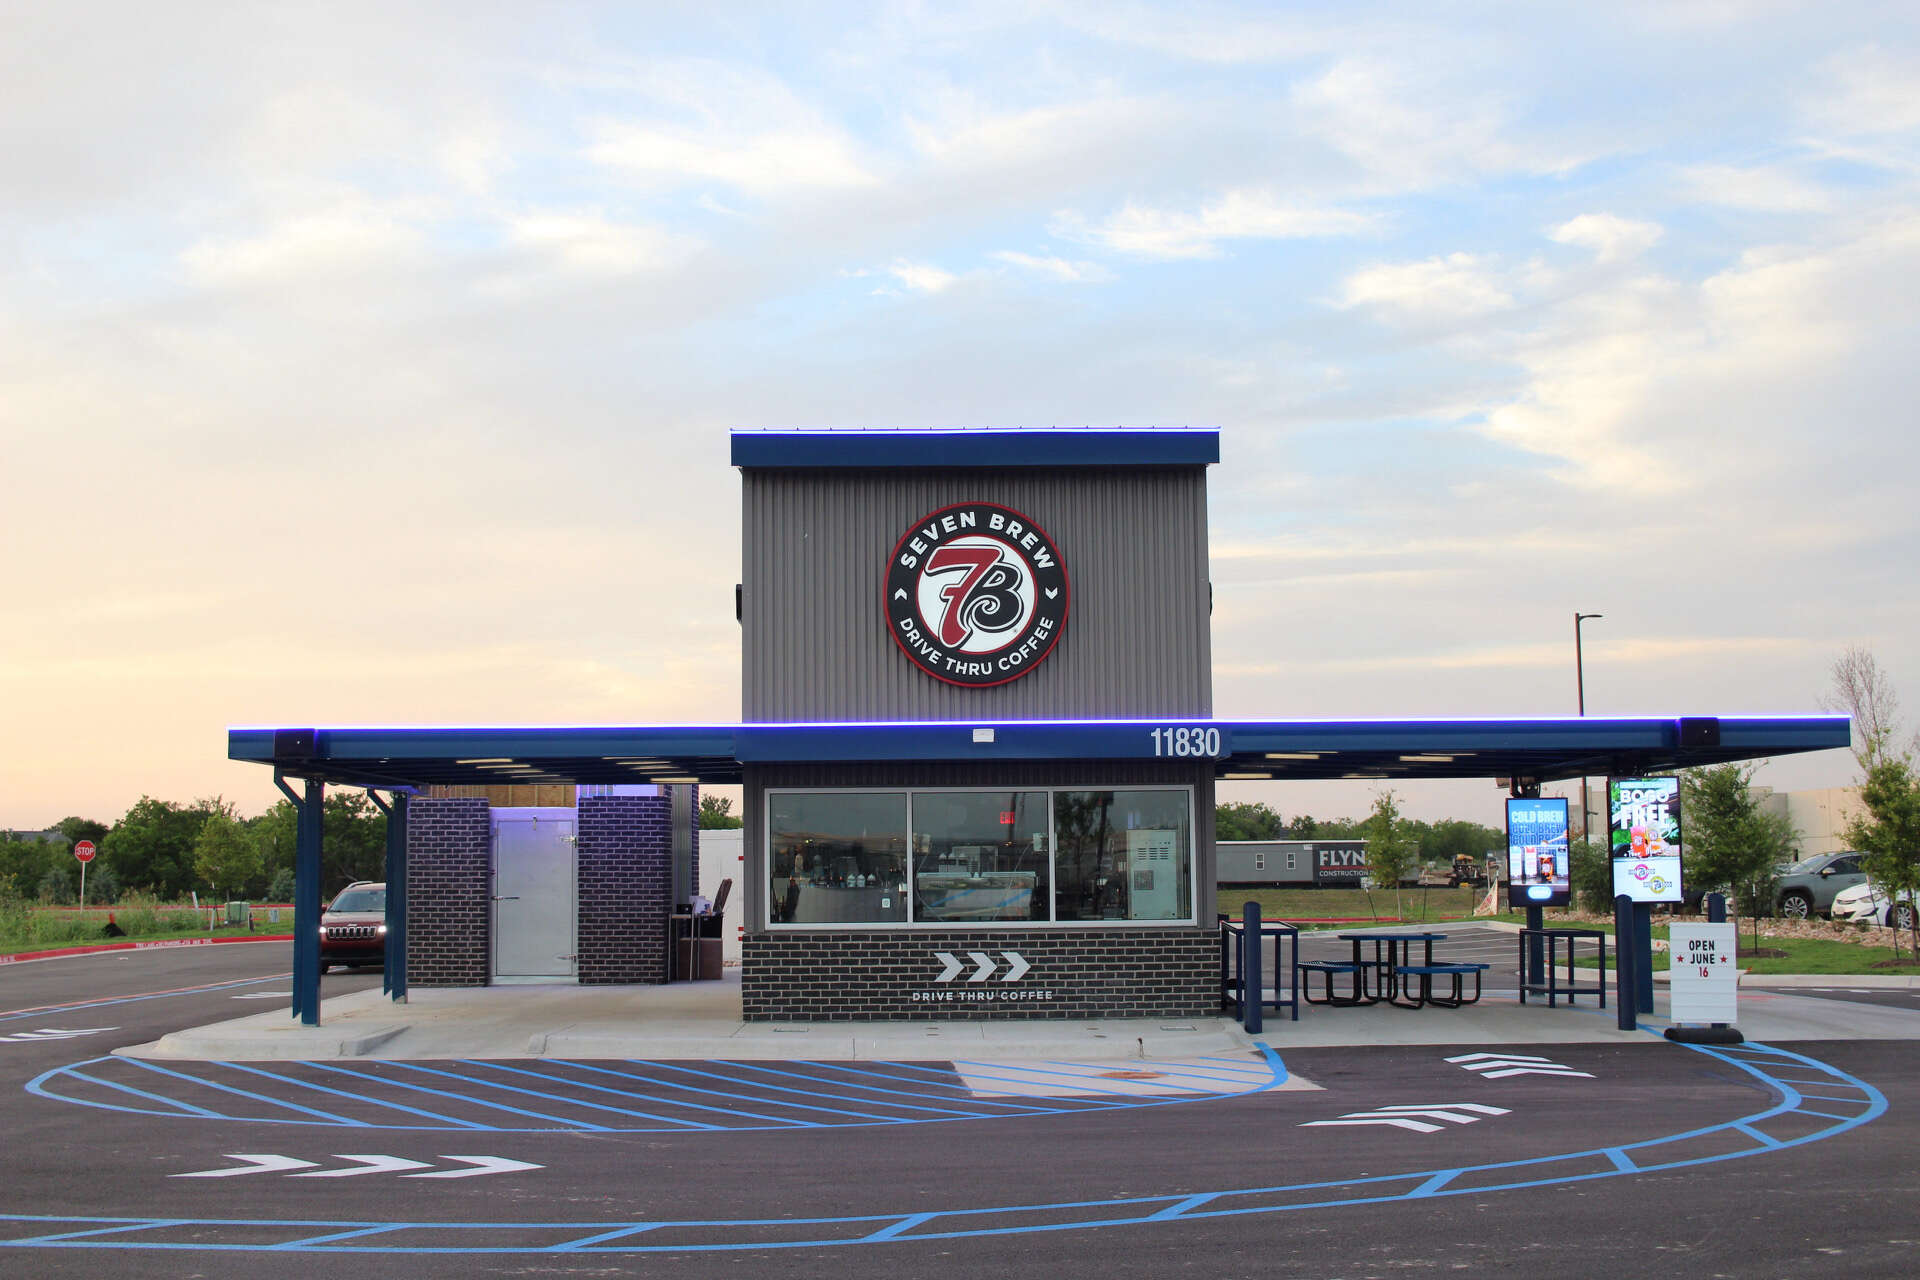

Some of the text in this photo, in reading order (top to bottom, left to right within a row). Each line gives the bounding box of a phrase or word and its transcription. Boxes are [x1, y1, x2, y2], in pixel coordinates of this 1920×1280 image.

[900, 511, 1055, 569] SEVEN BREW
[899, 616, 1054, 676] DRIVE THRU COFFEE
[1150, 727, 1220, 757] 11830
[1620, 789, 1670, 804] BOGO
[1511, 810, 1564, 823] COLD BREW
[1620, 804, 1670, 830] FREE
[76, 847, 94, 856] STOP
[1688, 939, 1715, 951] OPEN
[1690, 953, 1716, 965] JUNE
[1699, 966, 1709, 977] 16
[912, 990, 1053, 1001] DRIVE THRU COFFEE
